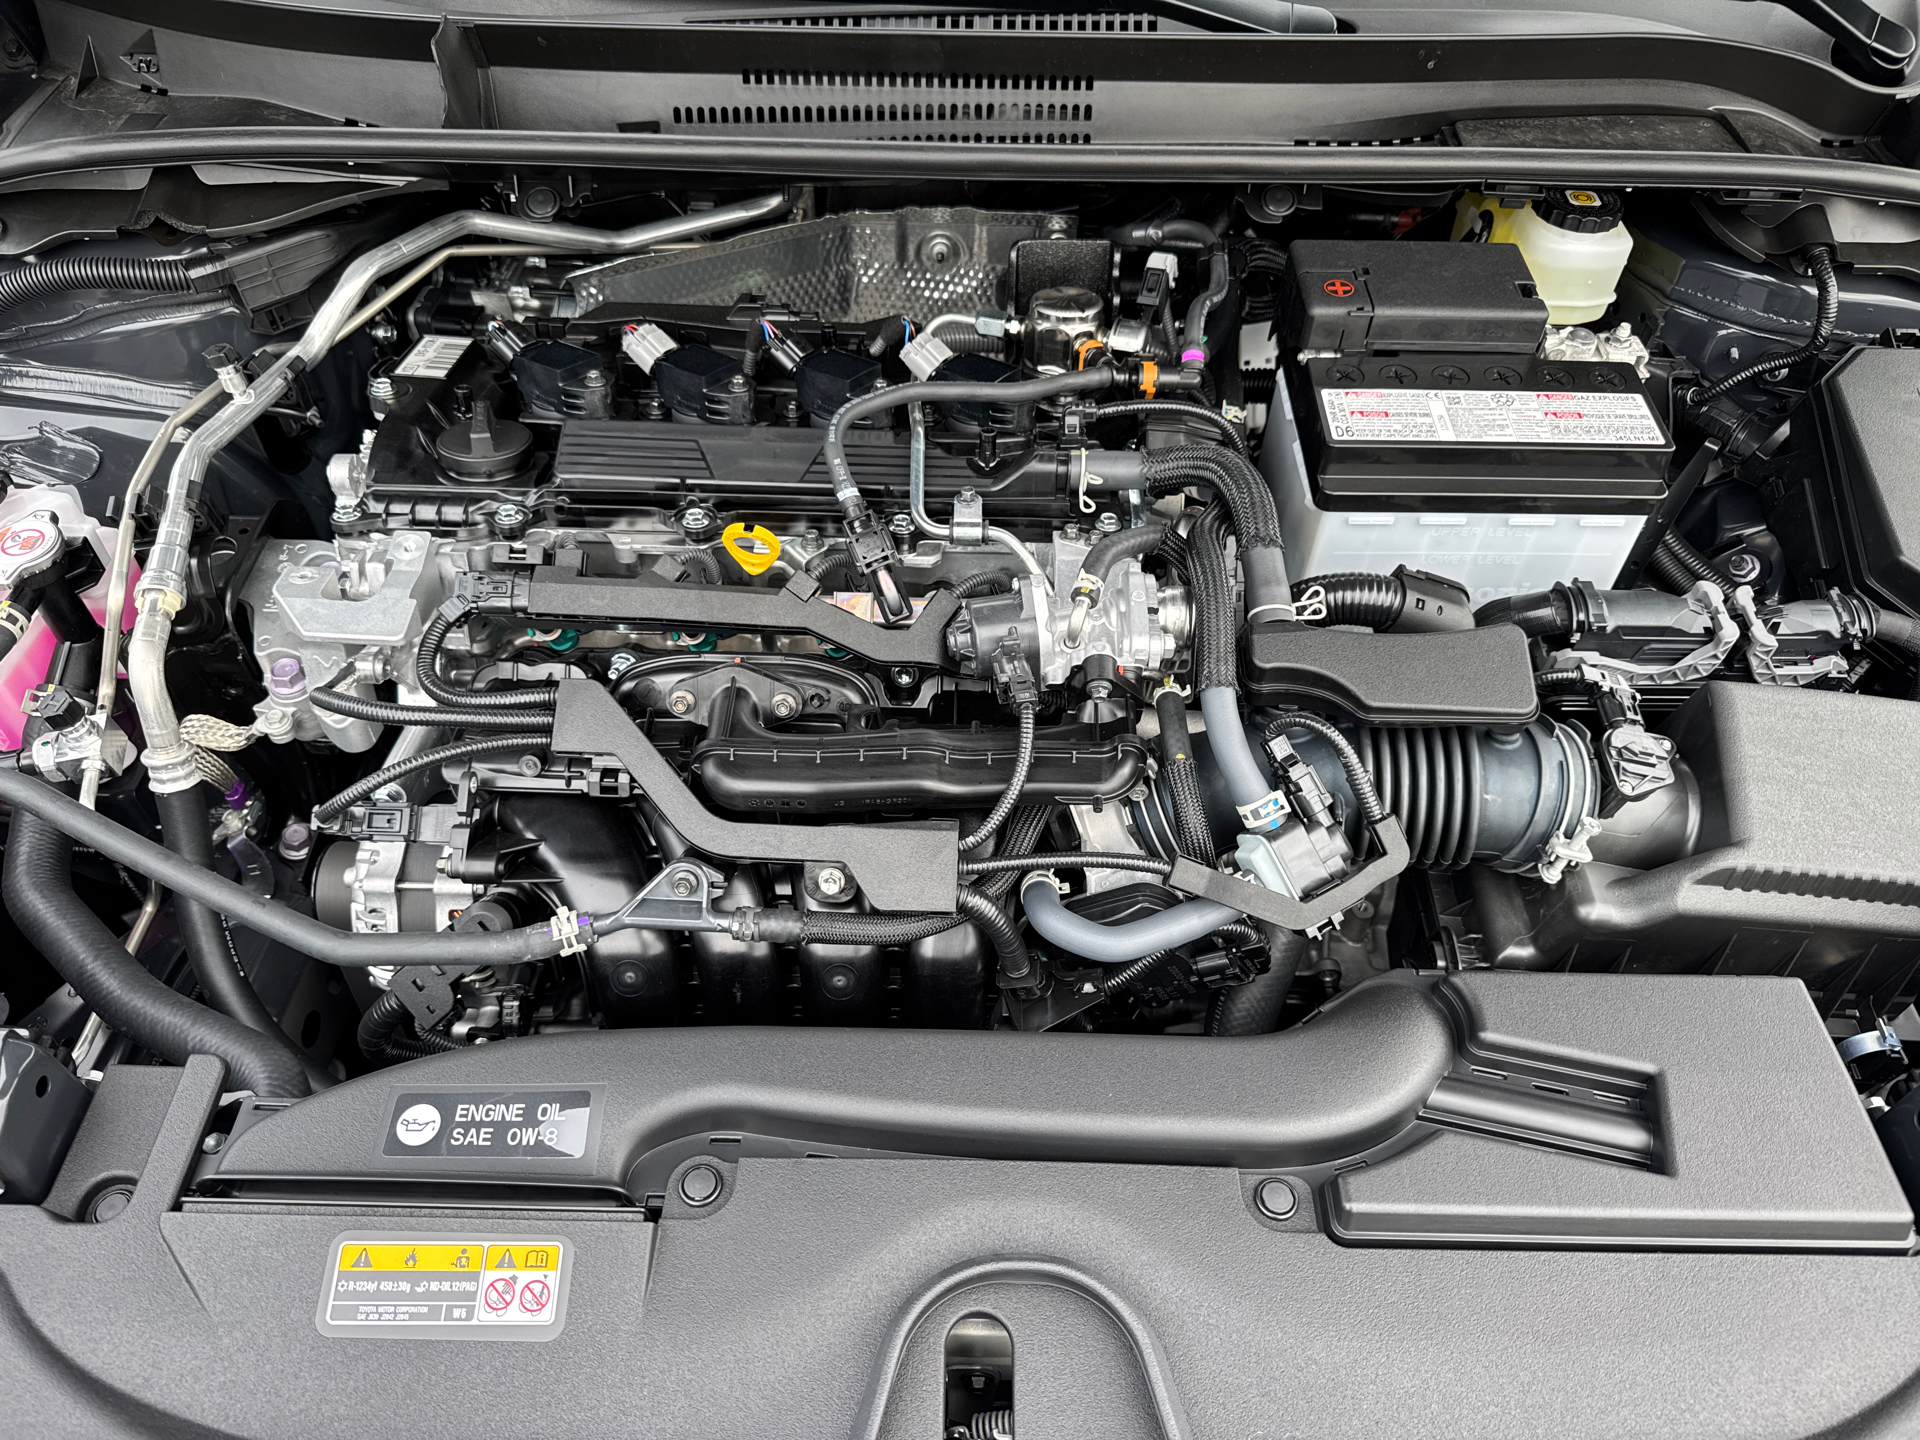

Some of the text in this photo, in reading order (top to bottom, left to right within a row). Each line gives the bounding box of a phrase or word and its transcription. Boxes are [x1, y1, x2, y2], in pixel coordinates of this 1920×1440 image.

[1335, 425, 1354, 438] D6
[1430, 527, 1533, 537] UPPER LEVEL
[1420, 555, 1520, 565] LOWER LEVEL
[454, 1103, 566, 1122] ENGINE OIL
[450, 1128, 493, 1146] SAE
[452, 1308, 467, 1319] W6
